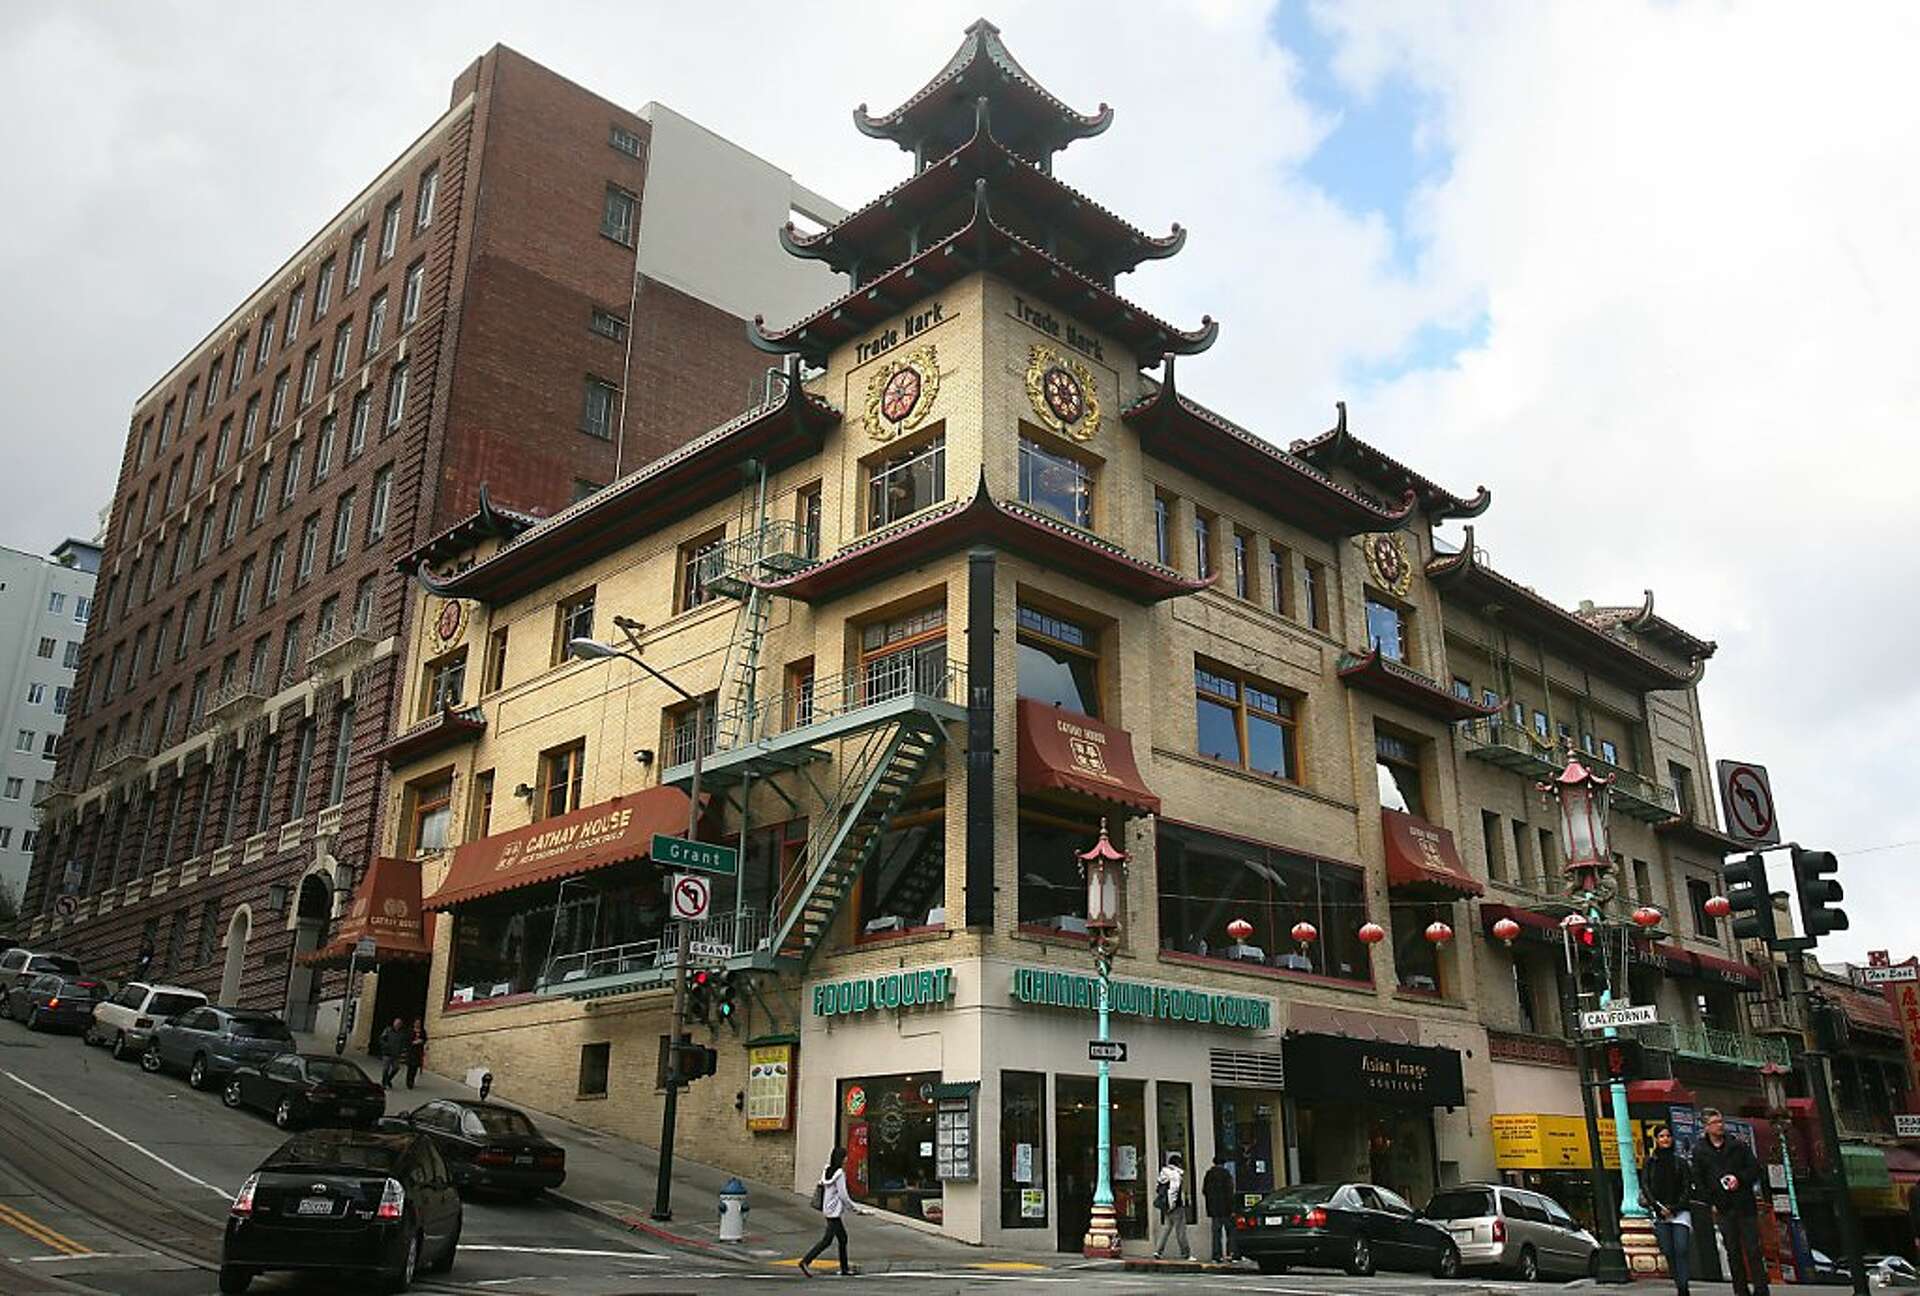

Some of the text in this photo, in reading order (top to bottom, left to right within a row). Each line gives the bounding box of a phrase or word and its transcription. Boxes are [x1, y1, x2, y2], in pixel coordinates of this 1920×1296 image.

[854, 329, 898, 364] Trade
[526, 809, 632, 853] CATHAY HOUSE
[670, 844, 720, 866] Grant
[692, 942, 729, 956] GRANT
[813, 968, 949, 1016] FOOD COURT
[1157, 986, 1209, 1023] FOOD
[1212, 995, 1270, 1029] COURT
[1588, 1009, 1651, 1025] CALIFORNIA
[1362, 1055, 1428, 1080] Asian Image
